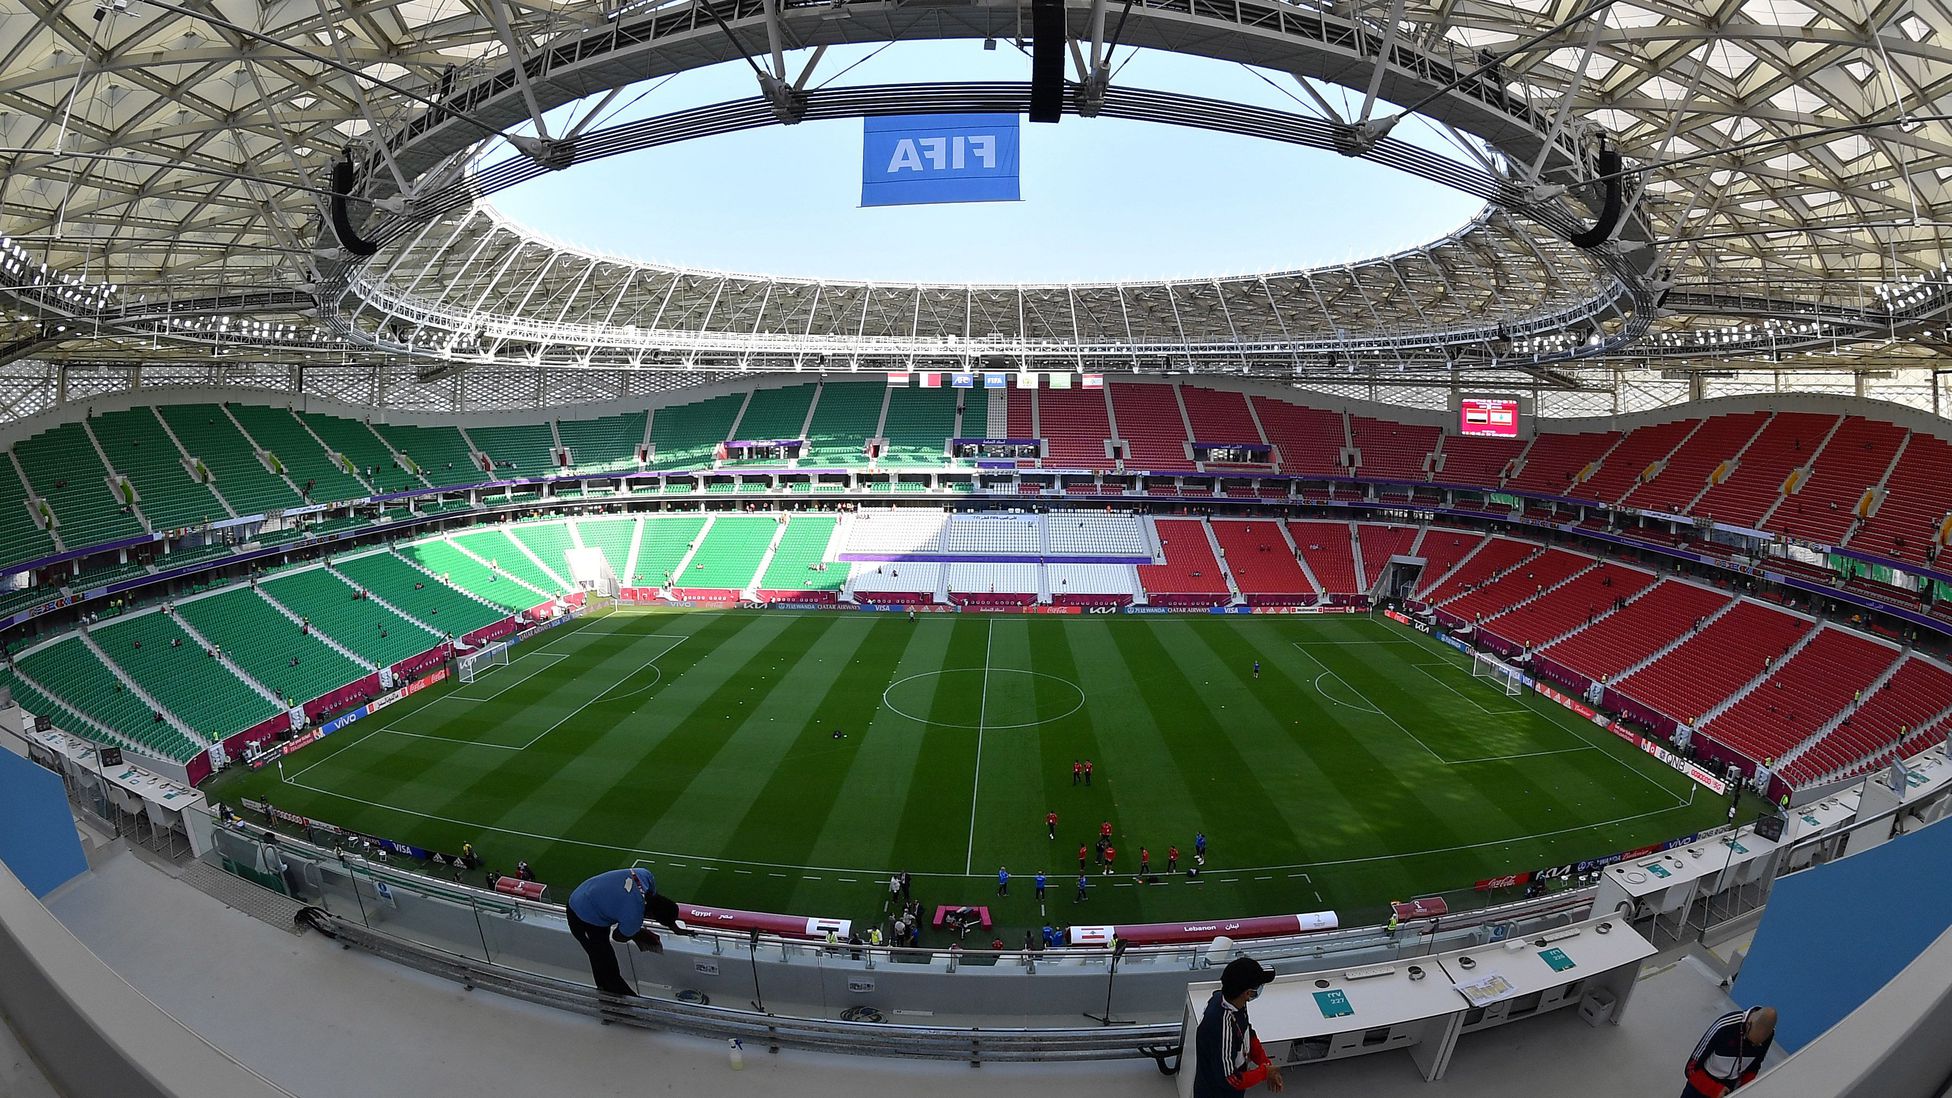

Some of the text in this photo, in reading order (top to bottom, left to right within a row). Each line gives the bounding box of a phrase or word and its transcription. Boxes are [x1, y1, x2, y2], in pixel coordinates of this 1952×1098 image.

[1089, 606, 1116, 614] KIA
[1414, 623, 1430, 634] KIA
[1522, 674, 1533, 688] VISA
[1665, 753, 1686, 772] QNB
[393, 843, 412, 855] VISA
[1487, 875, 1516, 889] Coca-Cola
[691, 909, 712, 917] Egypt
[1224, 923, 1240, 931] لبنان
